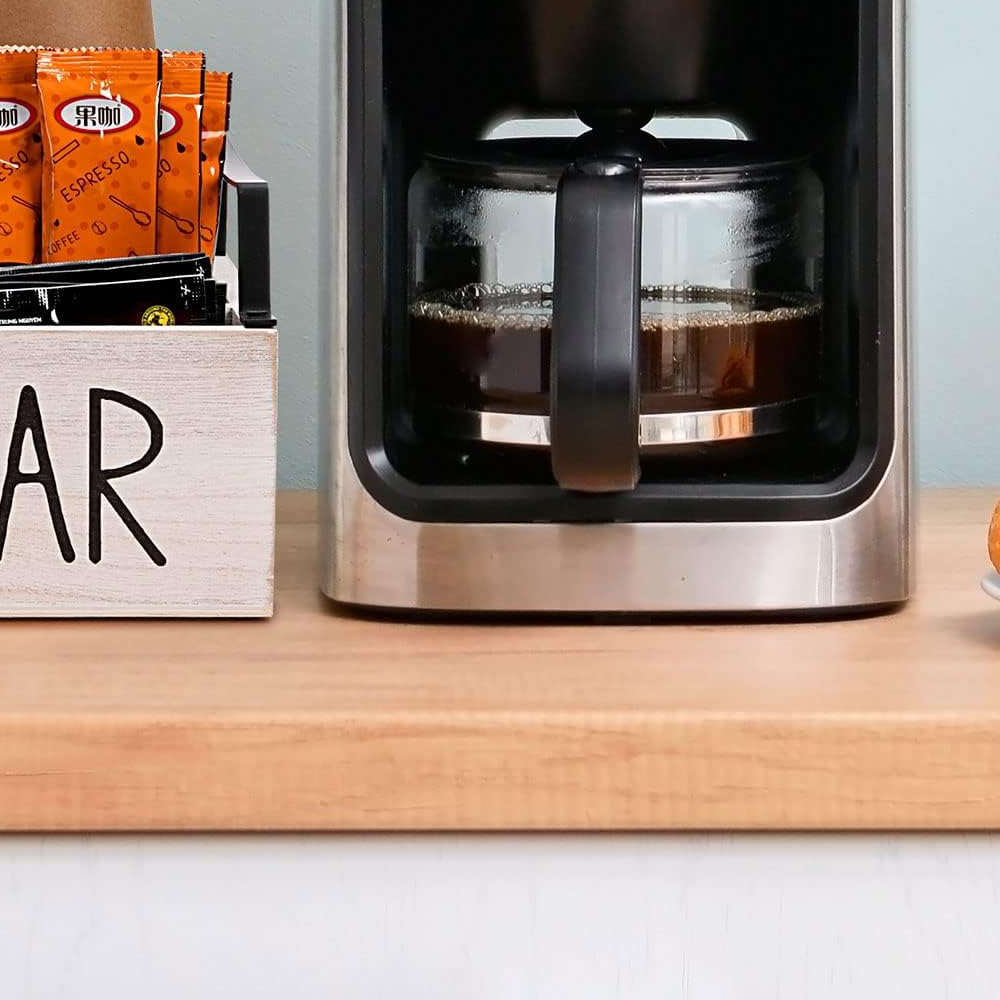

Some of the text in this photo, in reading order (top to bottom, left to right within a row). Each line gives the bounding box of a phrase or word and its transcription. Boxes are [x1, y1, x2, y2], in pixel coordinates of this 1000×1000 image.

[74, 104, 121, 127] 果咖
[60, 151, 130, 203] ESPRESSO
[47, 229, 80, 256] COFFEE
